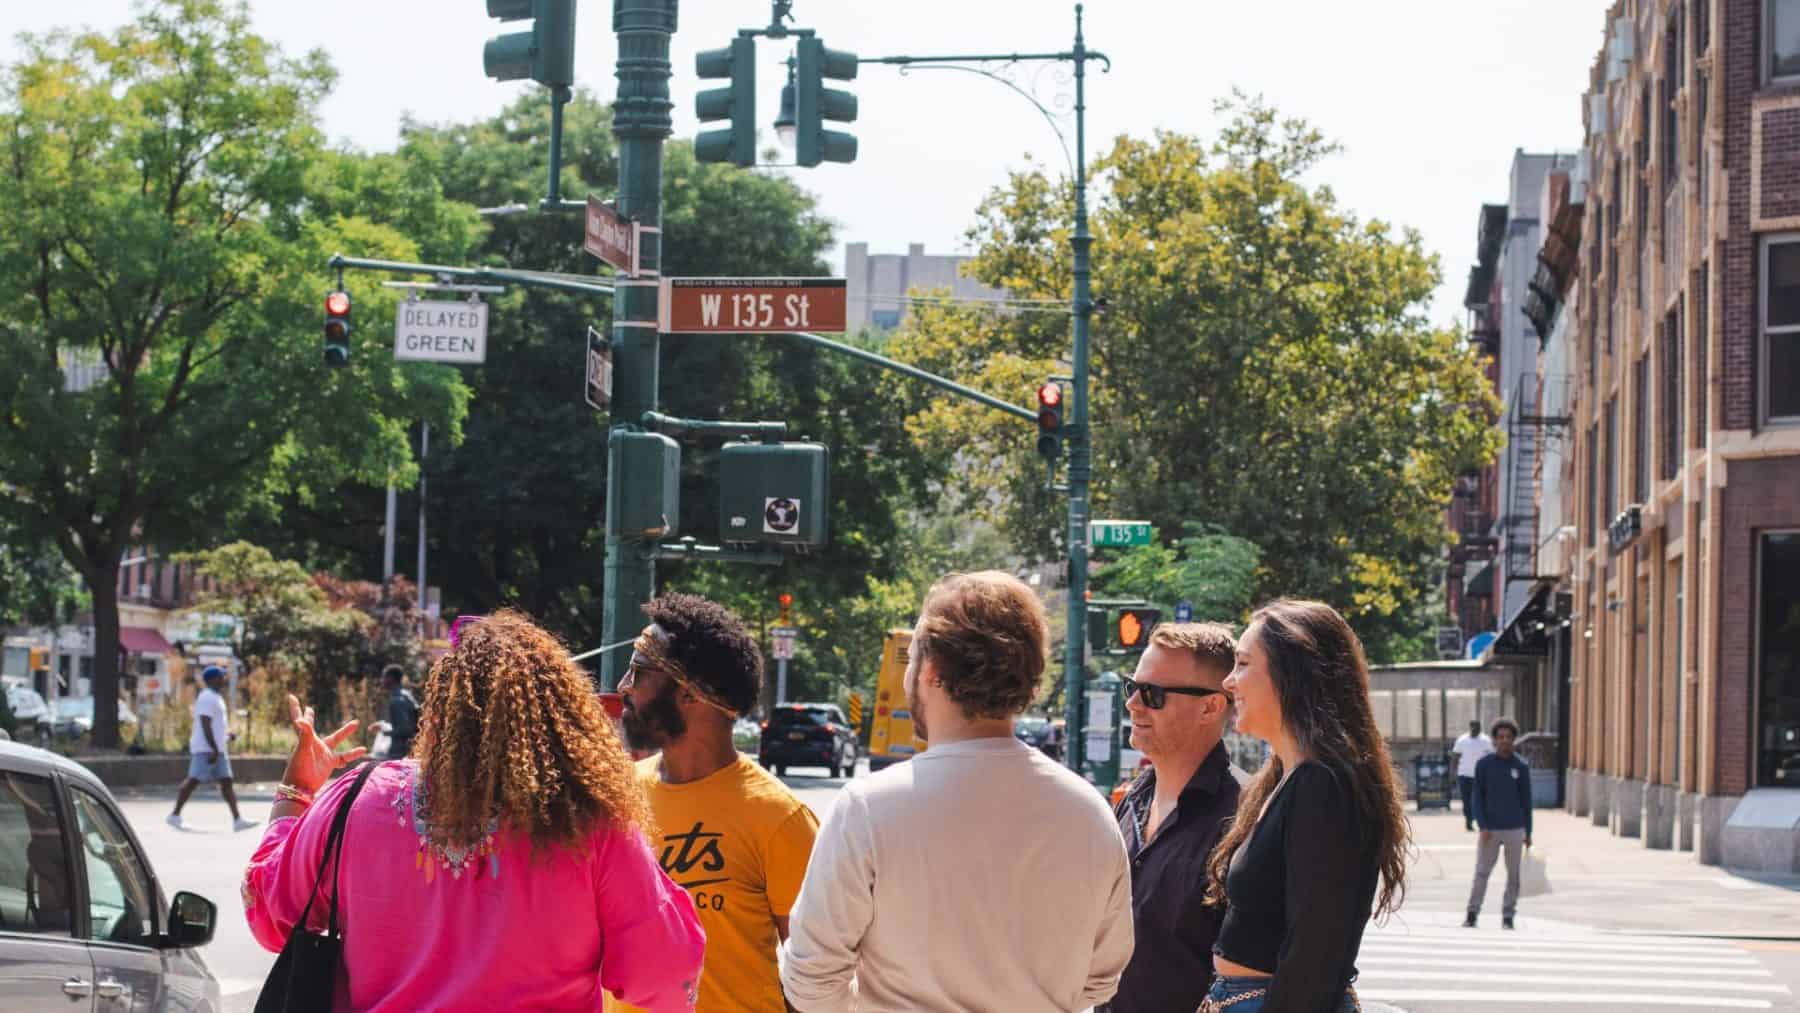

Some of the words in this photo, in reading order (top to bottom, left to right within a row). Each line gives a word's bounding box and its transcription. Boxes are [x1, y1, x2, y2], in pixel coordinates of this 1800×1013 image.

[405, 310, 479, 329] DELAYED
[701, 294, 721, 327] W
[732, 294, 773, 327] 135
[784, 294, 810, 327] St
[406, 335, 475, 353] GREEN
[1094, 525, 1105, 543] W
[1111, 525, 1132, 543] 135
